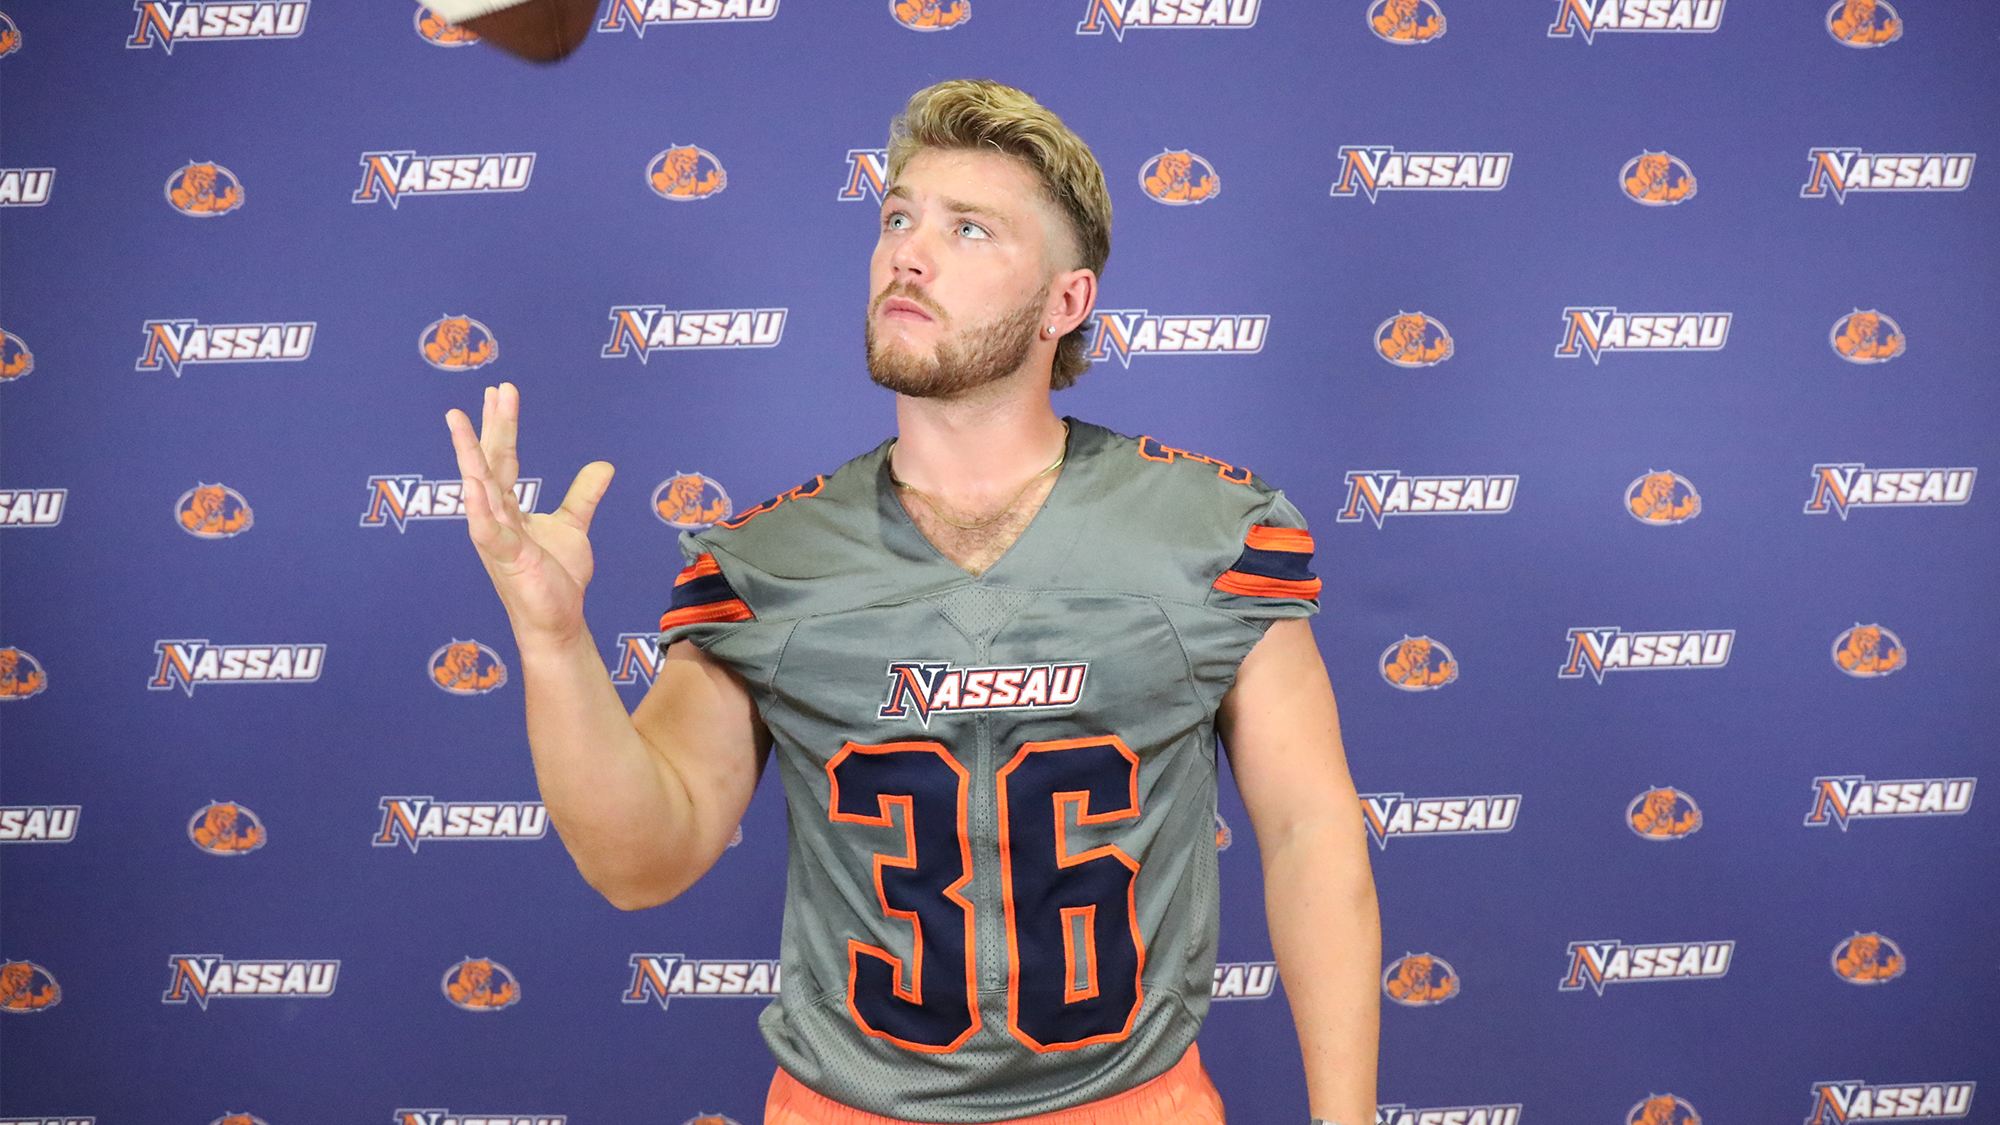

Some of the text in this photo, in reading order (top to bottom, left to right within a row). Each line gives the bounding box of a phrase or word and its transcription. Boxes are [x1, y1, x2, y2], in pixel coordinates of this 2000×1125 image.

[127, 0, 311, 53] NASSAU
[598, 0, 780, 38] NASSAU
[1077, 0, 1261, 41] NASSAU
[1548, 0, 1725, 44] NASSAU
[353, 151, 536, 208] NASSAU
[1331, 146, 1513, 203] NASSAU
[1801, 148, 1975, 204] NASSAU
[135, 319, 316, 377] NASSAU
[602, 305, 788, 364] NASSAU
[1087, 310, 1270, 368] NASSAU
[1555, 307, 1732, 364] NASSAU
[360, 475, 541, 532] NASU
[1337, 471, 1519, 528] NASSAU
[1804, 464, 1976, 520] NASSAU
[148, 639, 326, 696] NASSAU
[1559, 627, 1735, 684] NASSAU
[878, 662, 1088, 728] NASSAU
[373, 796, 548, 852] NASSAU
[1804, 776, 1976, 831] NASSAU
[825, 735, 1145, 1053] 36
[163, 955, 340, 1009] NASSAU
[1559, 940, 1735, 996] NASSAU
[1376, 1104, 1521, 1125] ASSAU
[1805, 1081, 1976, 1125] NASSAU
